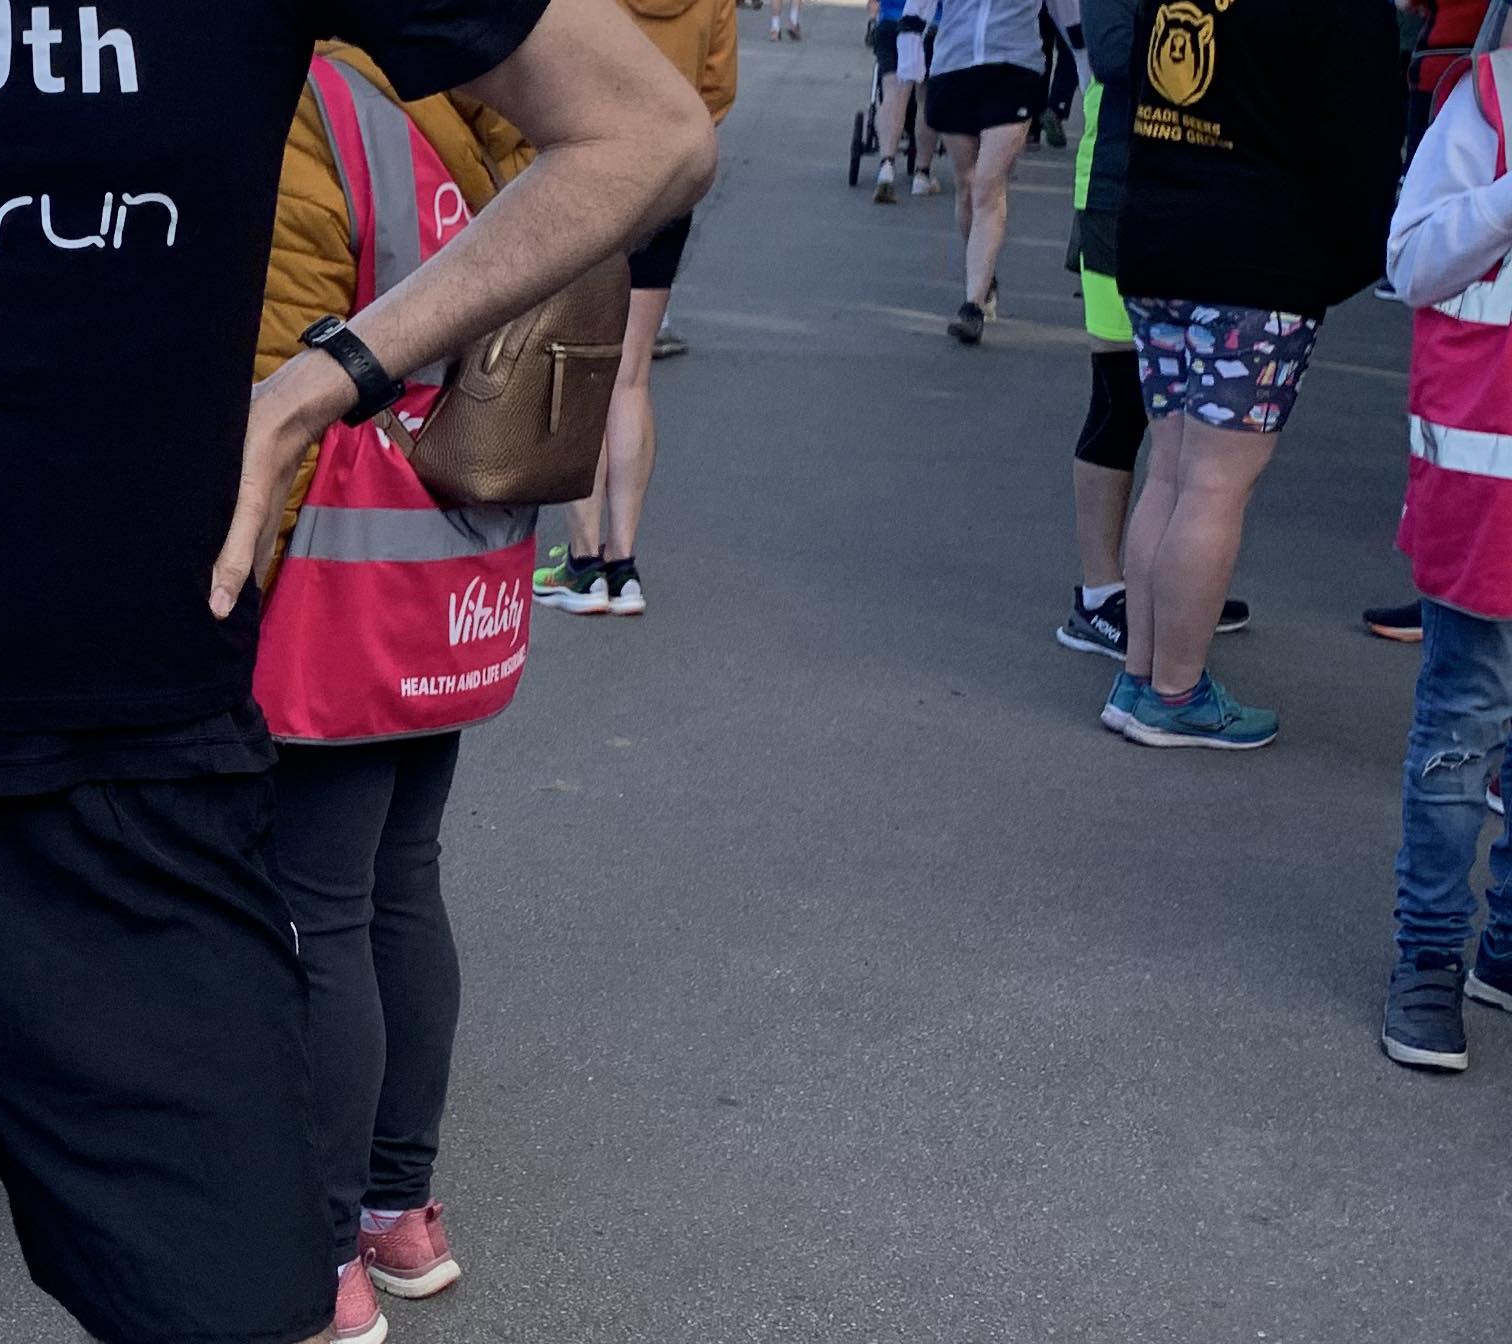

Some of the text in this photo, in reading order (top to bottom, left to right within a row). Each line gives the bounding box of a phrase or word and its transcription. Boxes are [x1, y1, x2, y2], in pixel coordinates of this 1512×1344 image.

[449, 575, 525, 647] Vitality
[1090, 614, 1122, 644] HOKA
[400, 674, 456, 697] HEALTH
[457, 669, 481, 691] AND
[482, 662, 500, 686] LIFE
